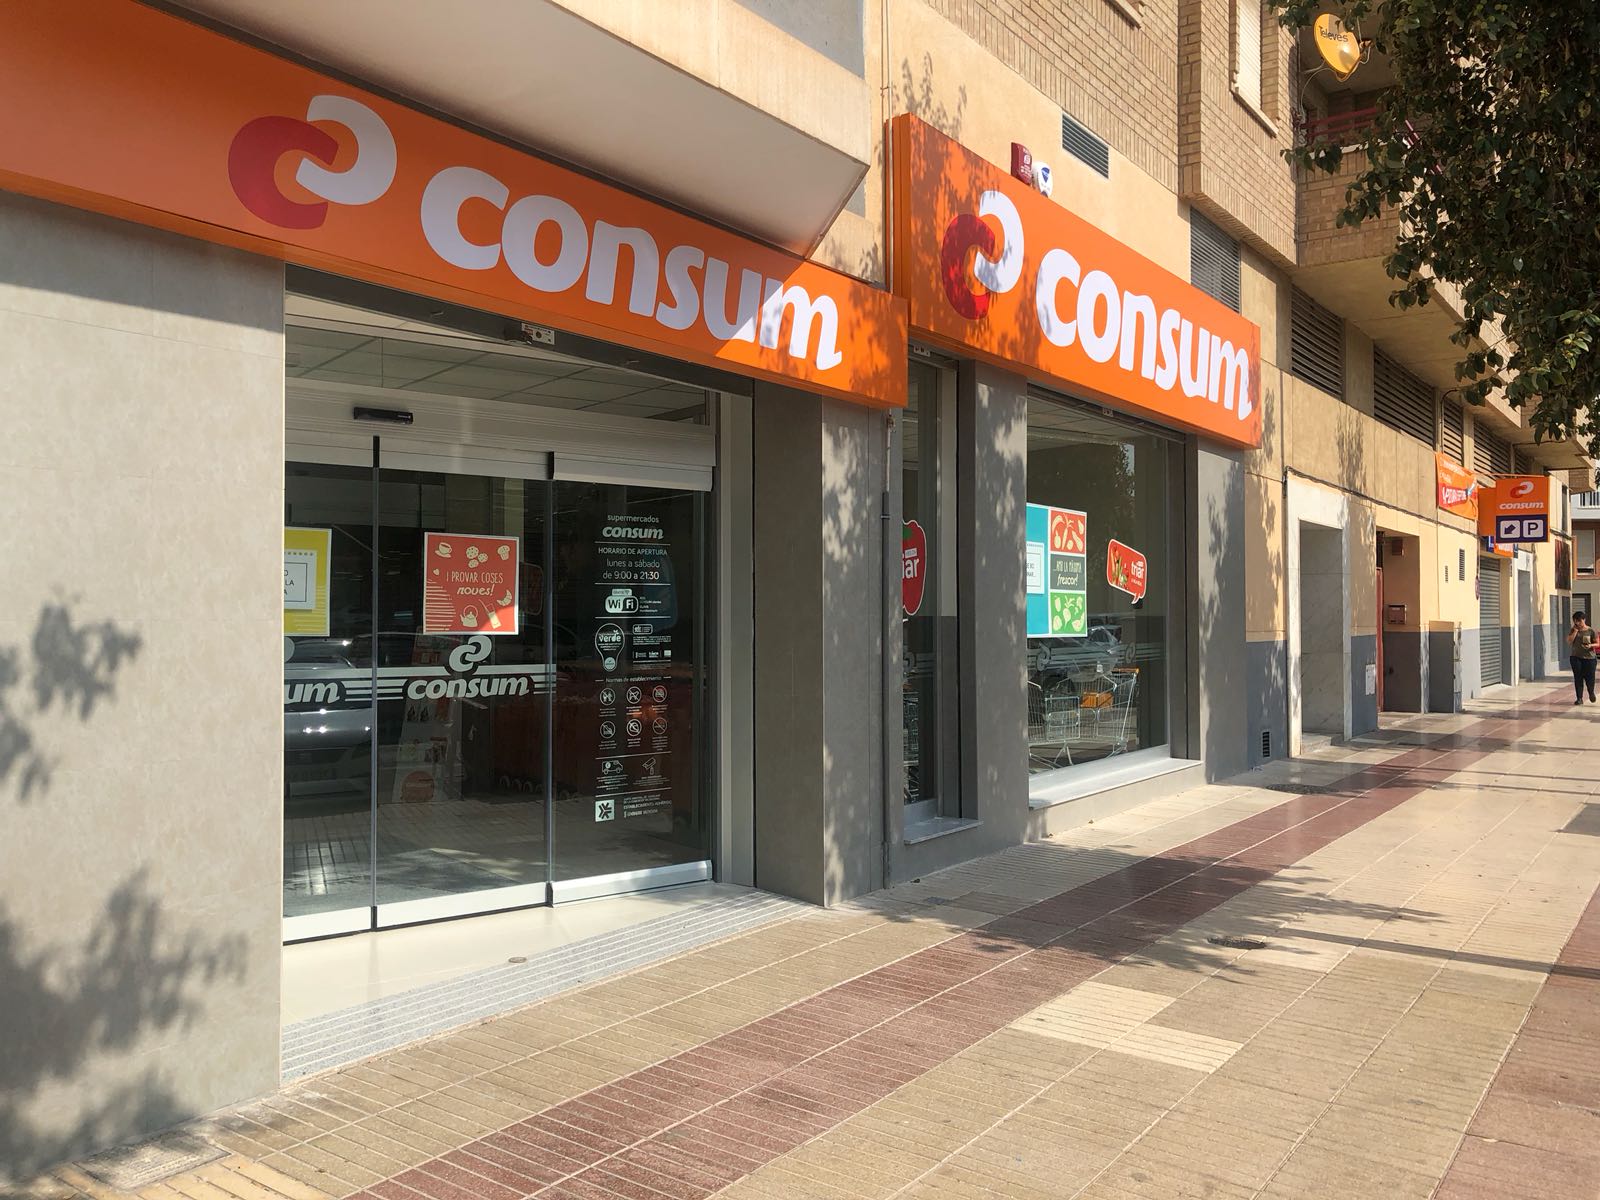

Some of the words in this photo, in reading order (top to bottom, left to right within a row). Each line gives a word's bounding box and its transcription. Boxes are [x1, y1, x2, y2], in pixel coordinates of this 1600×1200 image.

[421, 166, 842, 371] consum
[1036, 248, 1253, 421] consum
[1499, 501, 1544, 510] consum
[607, 514, 660, 523] supermercados
[602, 526, 664, 540] consum
[1527, 522, 1539, 535] P
[598, 547, 627, 555] HORARIO
[637, 548, 668, 556] APERTURA
[606, 558, 626, 568] lunes
[451, 570, 479, 583] PROVAR
[481, 572, 504, 584] COSES
[602, 571, 612, 580] de
[640, 571, 660, 580] 21:30
[407, 675, 530, 700] consum
